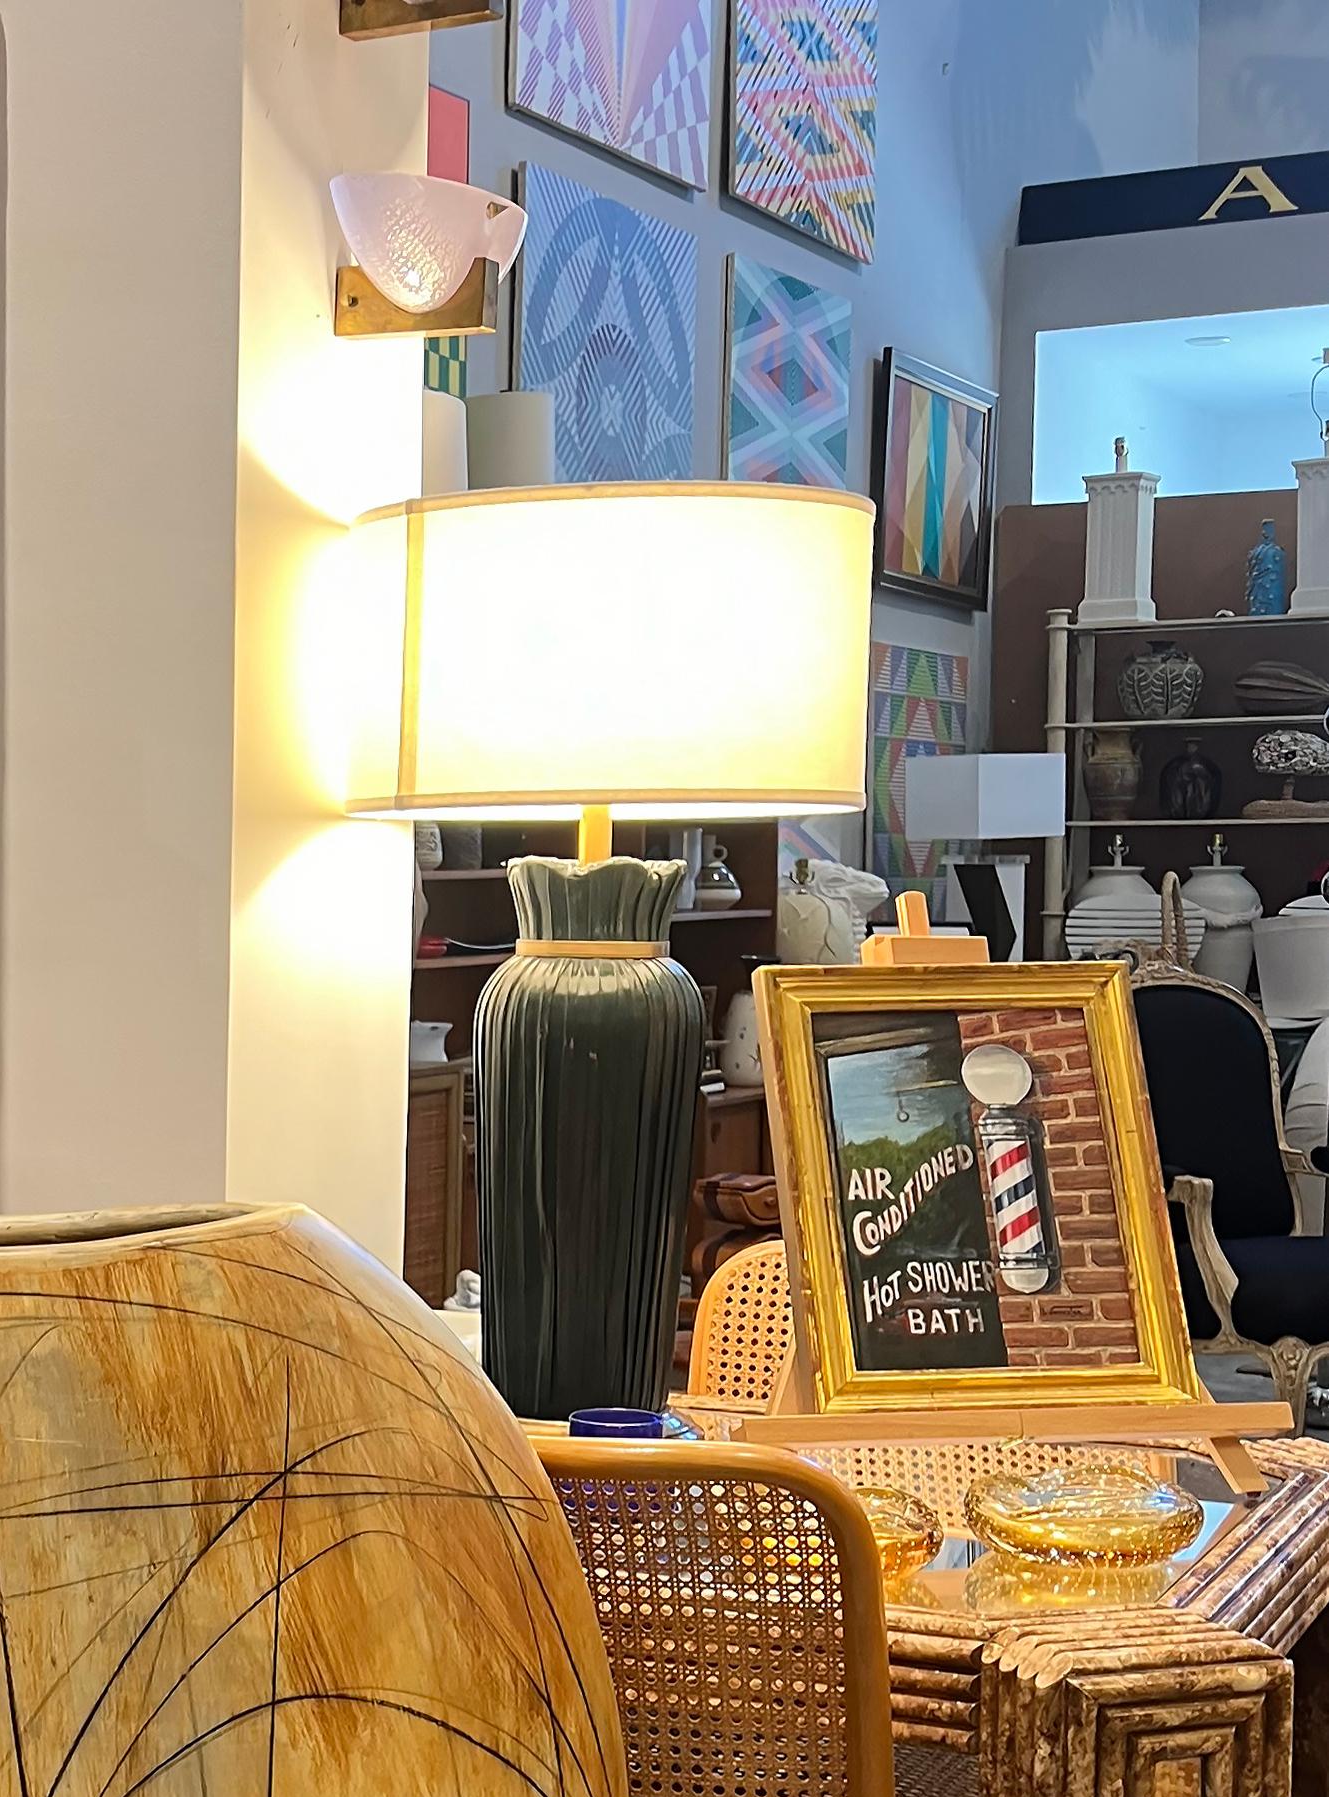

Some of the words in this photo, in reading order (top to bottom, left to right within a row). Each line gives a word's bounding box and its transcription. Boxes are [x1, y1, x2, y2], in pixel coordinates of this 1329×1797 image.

[1198, 165, 1299, 220] A
[848, 1167, 895, 1200] AIR
[853, 1144, 974, 1256] CONDITIONED
[906, 1261, 995, 1293] SHOWER
[907, 1308, 984, 1334] BATH
